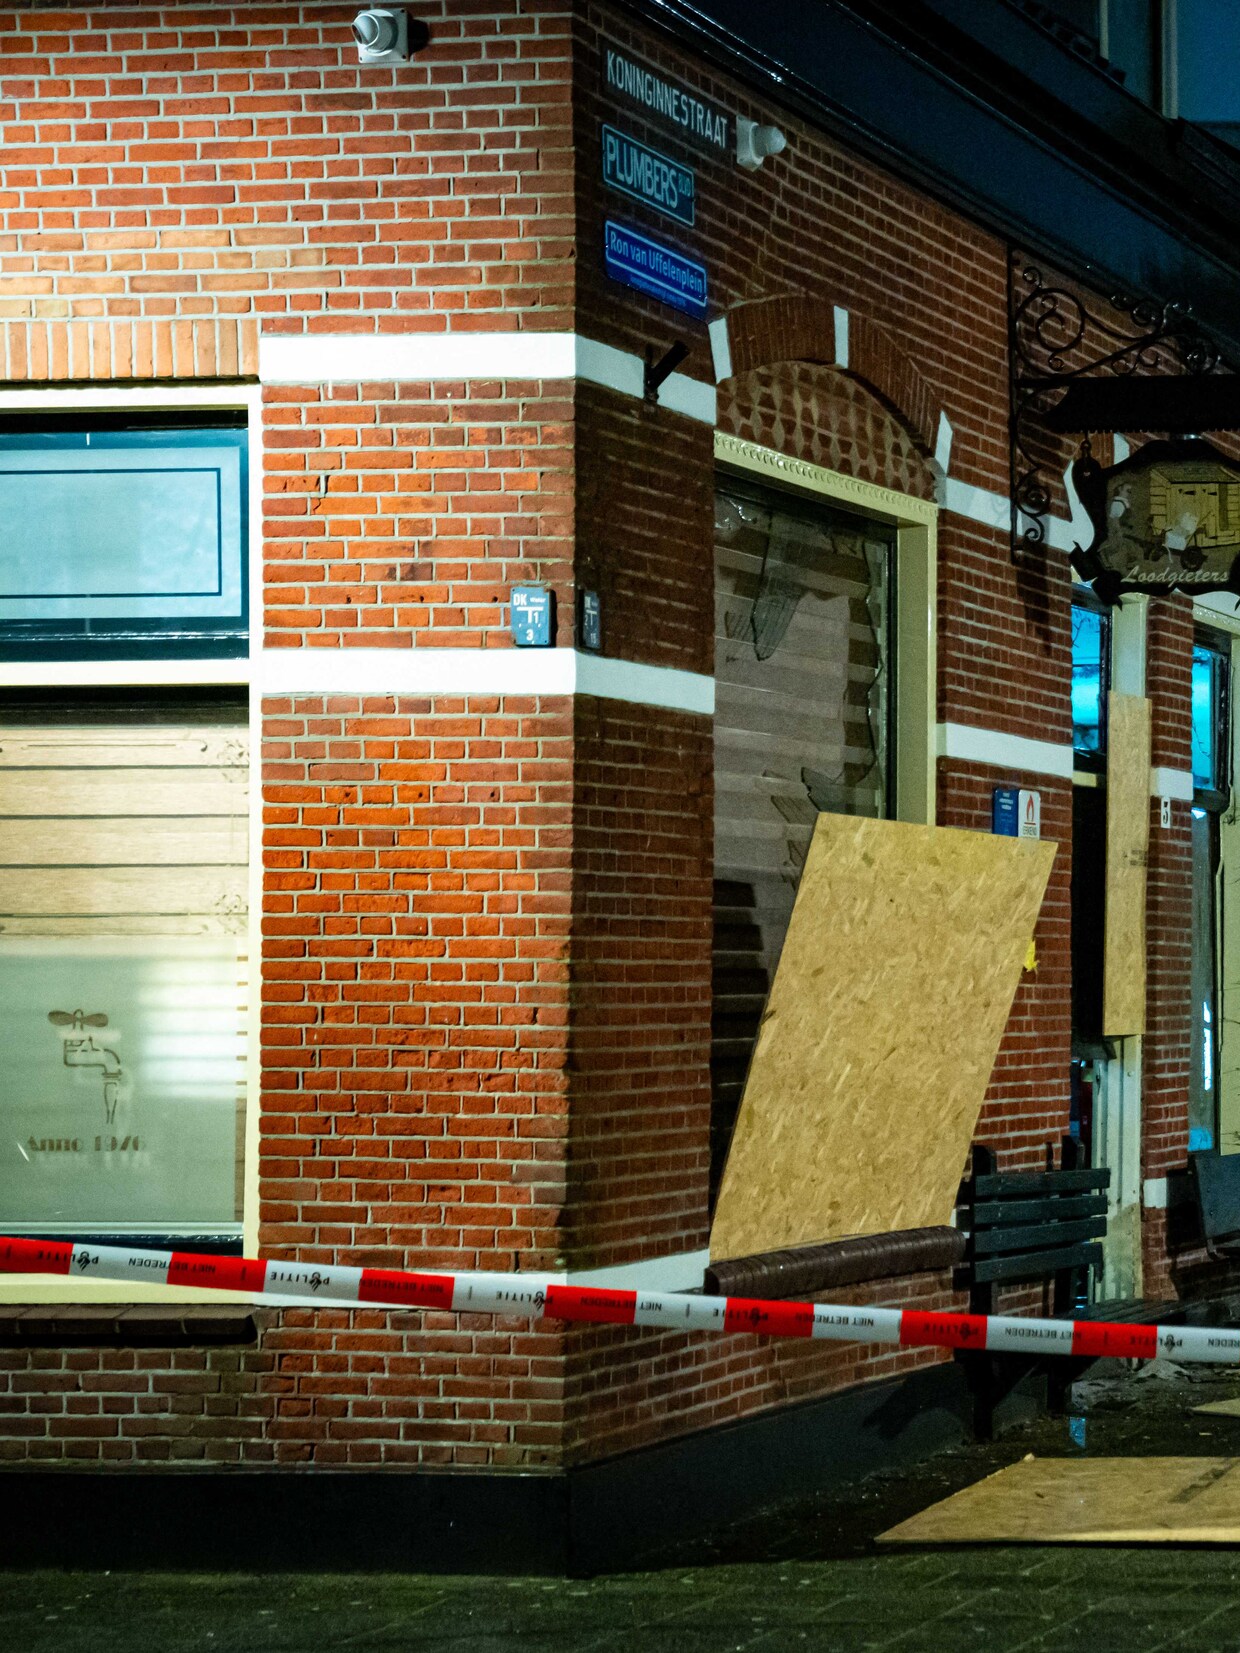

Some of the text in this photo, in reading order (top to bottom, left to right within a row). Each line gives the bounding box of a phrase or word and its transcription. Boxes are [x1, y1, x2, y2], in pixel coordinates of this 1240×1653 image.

[607, 49, 728, 149] KONINGINNESTRAAT
[606, 134, 677, 209] PLUMBERS
[610, 231, 629, 257] Ron
[630, 244, 647, 266] van
[648, 249, 703, 293] Uffelenplein
[1120, 566, 1230, 587] Loodgieters
[513, 593, 527, 606] DK
[128, 1257, 189, 1272] BETREDEN
[270, 1272, 330, 1292] POLITIE
[496, 1290, 553, 1310] POLITIE
[640, 1301, 662, 1312] NIET
[795, 1312, 874, 1327] NIET BETREDEN
[1004, 1327, 1057, 1339] BETREDEN
